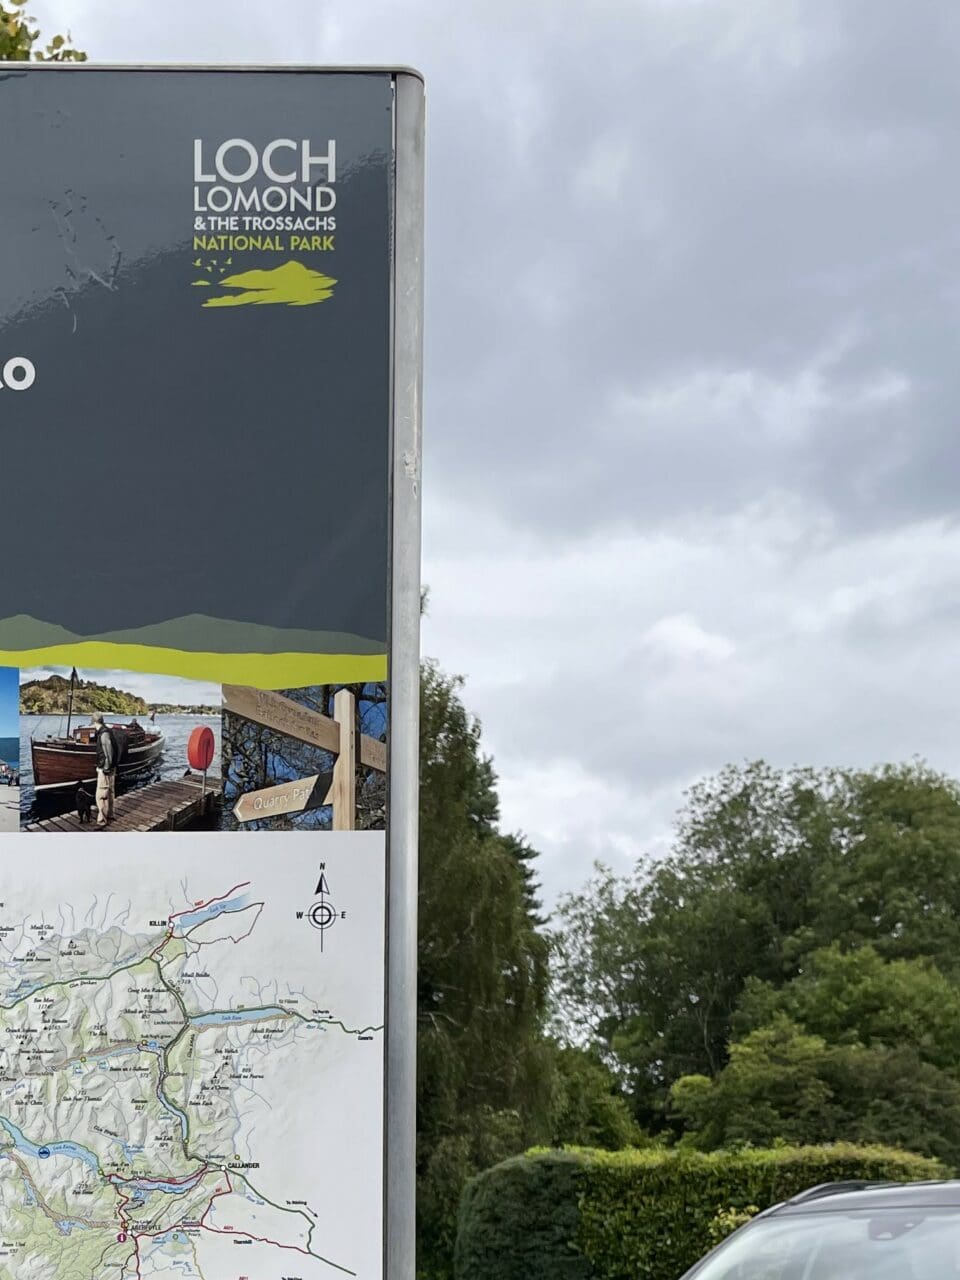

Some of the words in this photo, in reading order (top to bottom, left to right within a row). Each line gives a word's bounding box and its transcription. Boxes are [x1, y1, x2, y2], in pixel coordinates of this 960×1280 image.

[195, 139, 335, 183] LOCH
[194, 186, 336, 211] LOMOND
[194, 216, 207, 230] &
[208, 217, 239, 230] THE
[243, 217, 336, 230] TROSSACHS
[194, 235, 284, 250] NATIONAL
[291, 236, 334, 250] PARK
